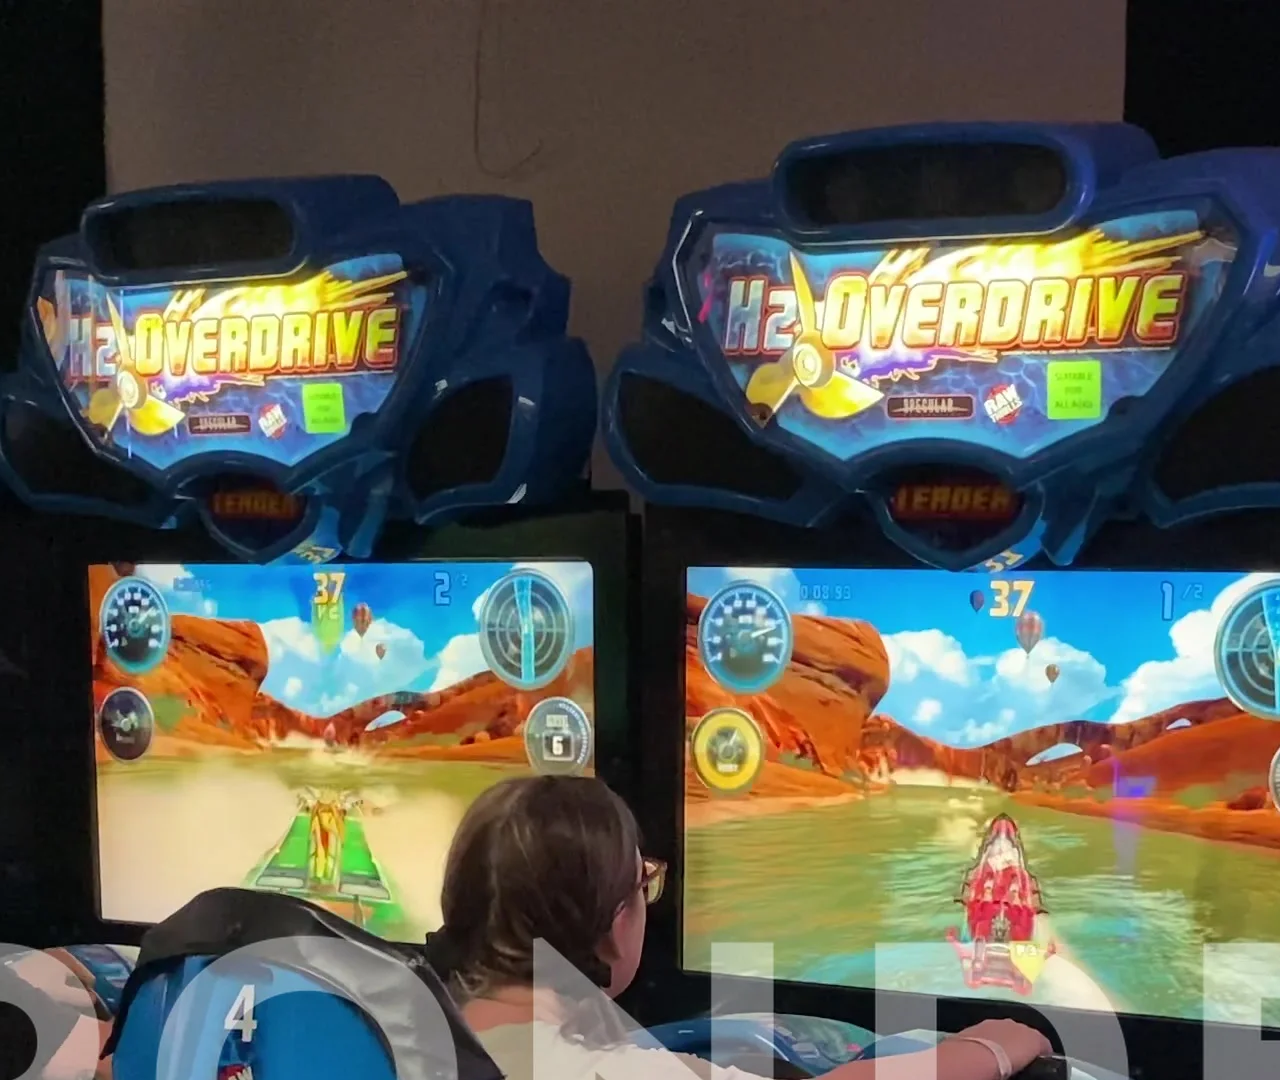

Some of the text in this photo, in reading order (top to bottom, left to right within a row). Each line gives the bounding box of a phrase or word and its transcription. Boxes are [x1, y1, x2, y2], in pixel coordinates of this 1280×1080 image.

[820, 272, 1191, 352] OVERDRIVE
[133, 308, 399, 376] OVERDRIVE
[312, 571, 346, 606] 37
[433, 571, 452, 606] 2
[988, 579, 1036, 618] 37
[1160, 581, 1175, 622] 1
[224, 984, 258, 1043] 4
